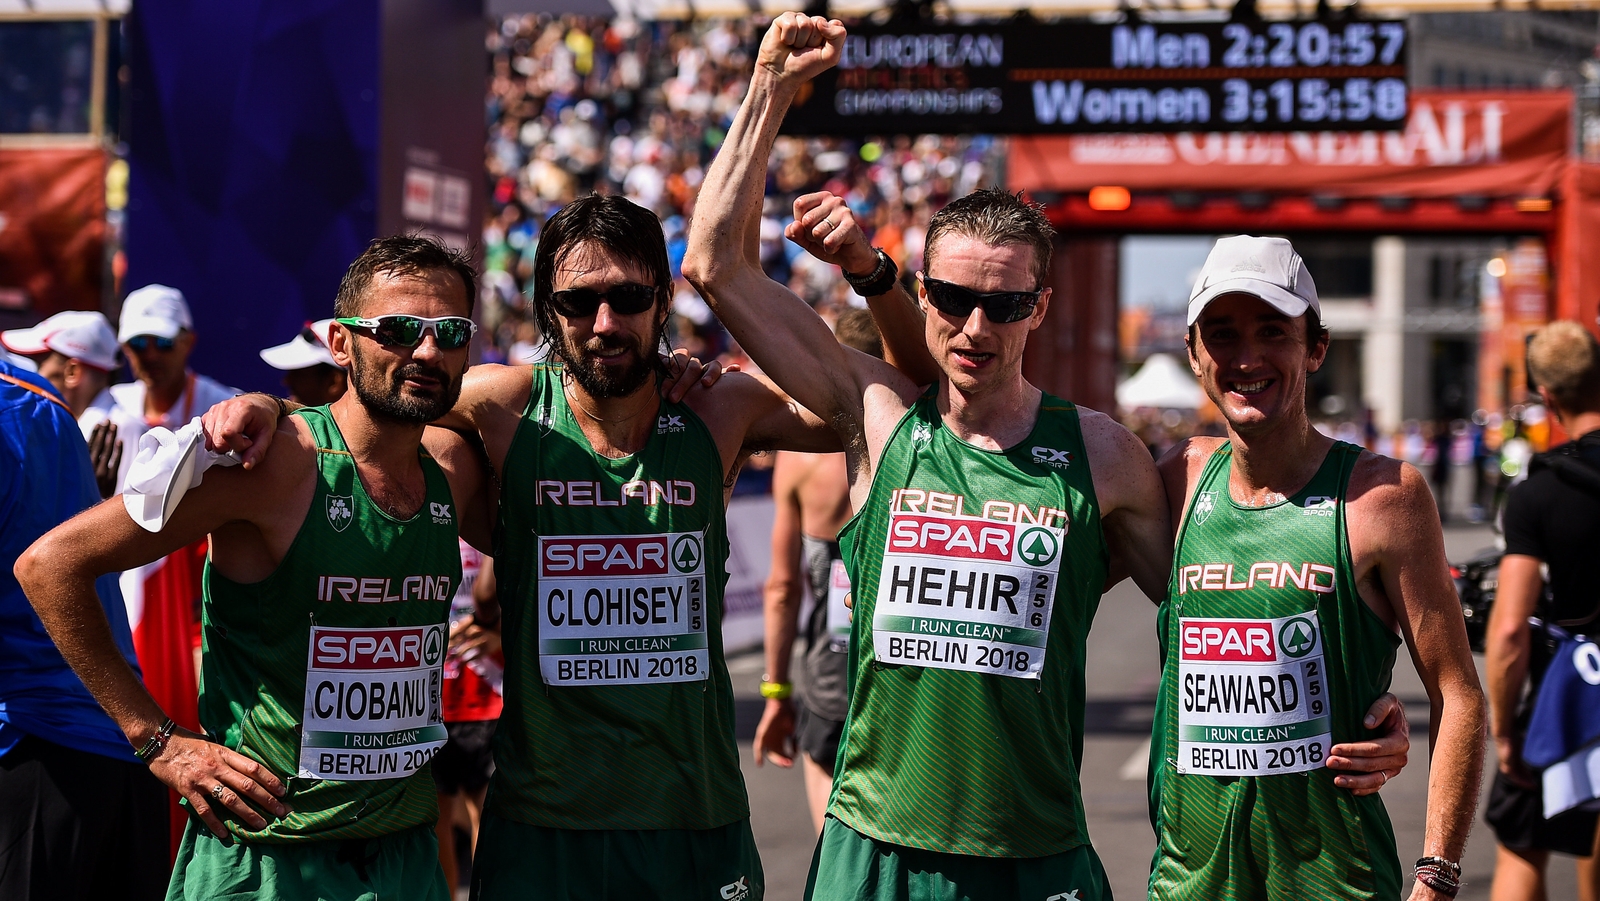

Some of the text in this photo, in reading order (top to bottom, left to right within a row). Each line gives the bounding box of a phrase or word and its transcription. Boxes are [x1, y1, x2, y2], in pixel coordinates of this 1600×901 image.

[1112, 22, 1405, 69] Men 2:20:57
[1032, 78, 1407, 124] Women 3:15:58
[1031, 446, 1070, 463] CX
[535, 480, 696, 507] IRELAND
[430, 501, 452, 518] CX
[892, 520, 1011, 556] SPAR
[546, 543, 666, 572] SPAR
[317, 575, 451, 603] IRELAND
[889, 565, 1021, 615] HEHIR
[1179, 561, 1336, 594] IRELAND
[547, 585, 683, 627] CLOHISEY
[911, 618, 915, 631] I
[919, 620, 950, 635] RUN
[1184, 626, 1272, 656] SPAR
[317, 635, 420, 664] SPAR
[580, 641, 584, 652] I
[588, 639, 620, 652] RUN
[889, 637, 1030, 672] BERLIN 2018
[557, 655, 698, 681] BERLIN 2018
[314, 677, 426, 721] CIOBANU
[1184, 673, 1299, 714] SEAWARD
[344, 736, 348, 747] I
[352, 734, 382, 748] RUN
[1205, 729, 1208, 740] I
[1211, 730, 1238, 741] RUN
[318, 752, 398, 775] BERLIN
[1192, 741, 1324, 771] BERLIN 2018
[720, 875, 748, 900] CX
